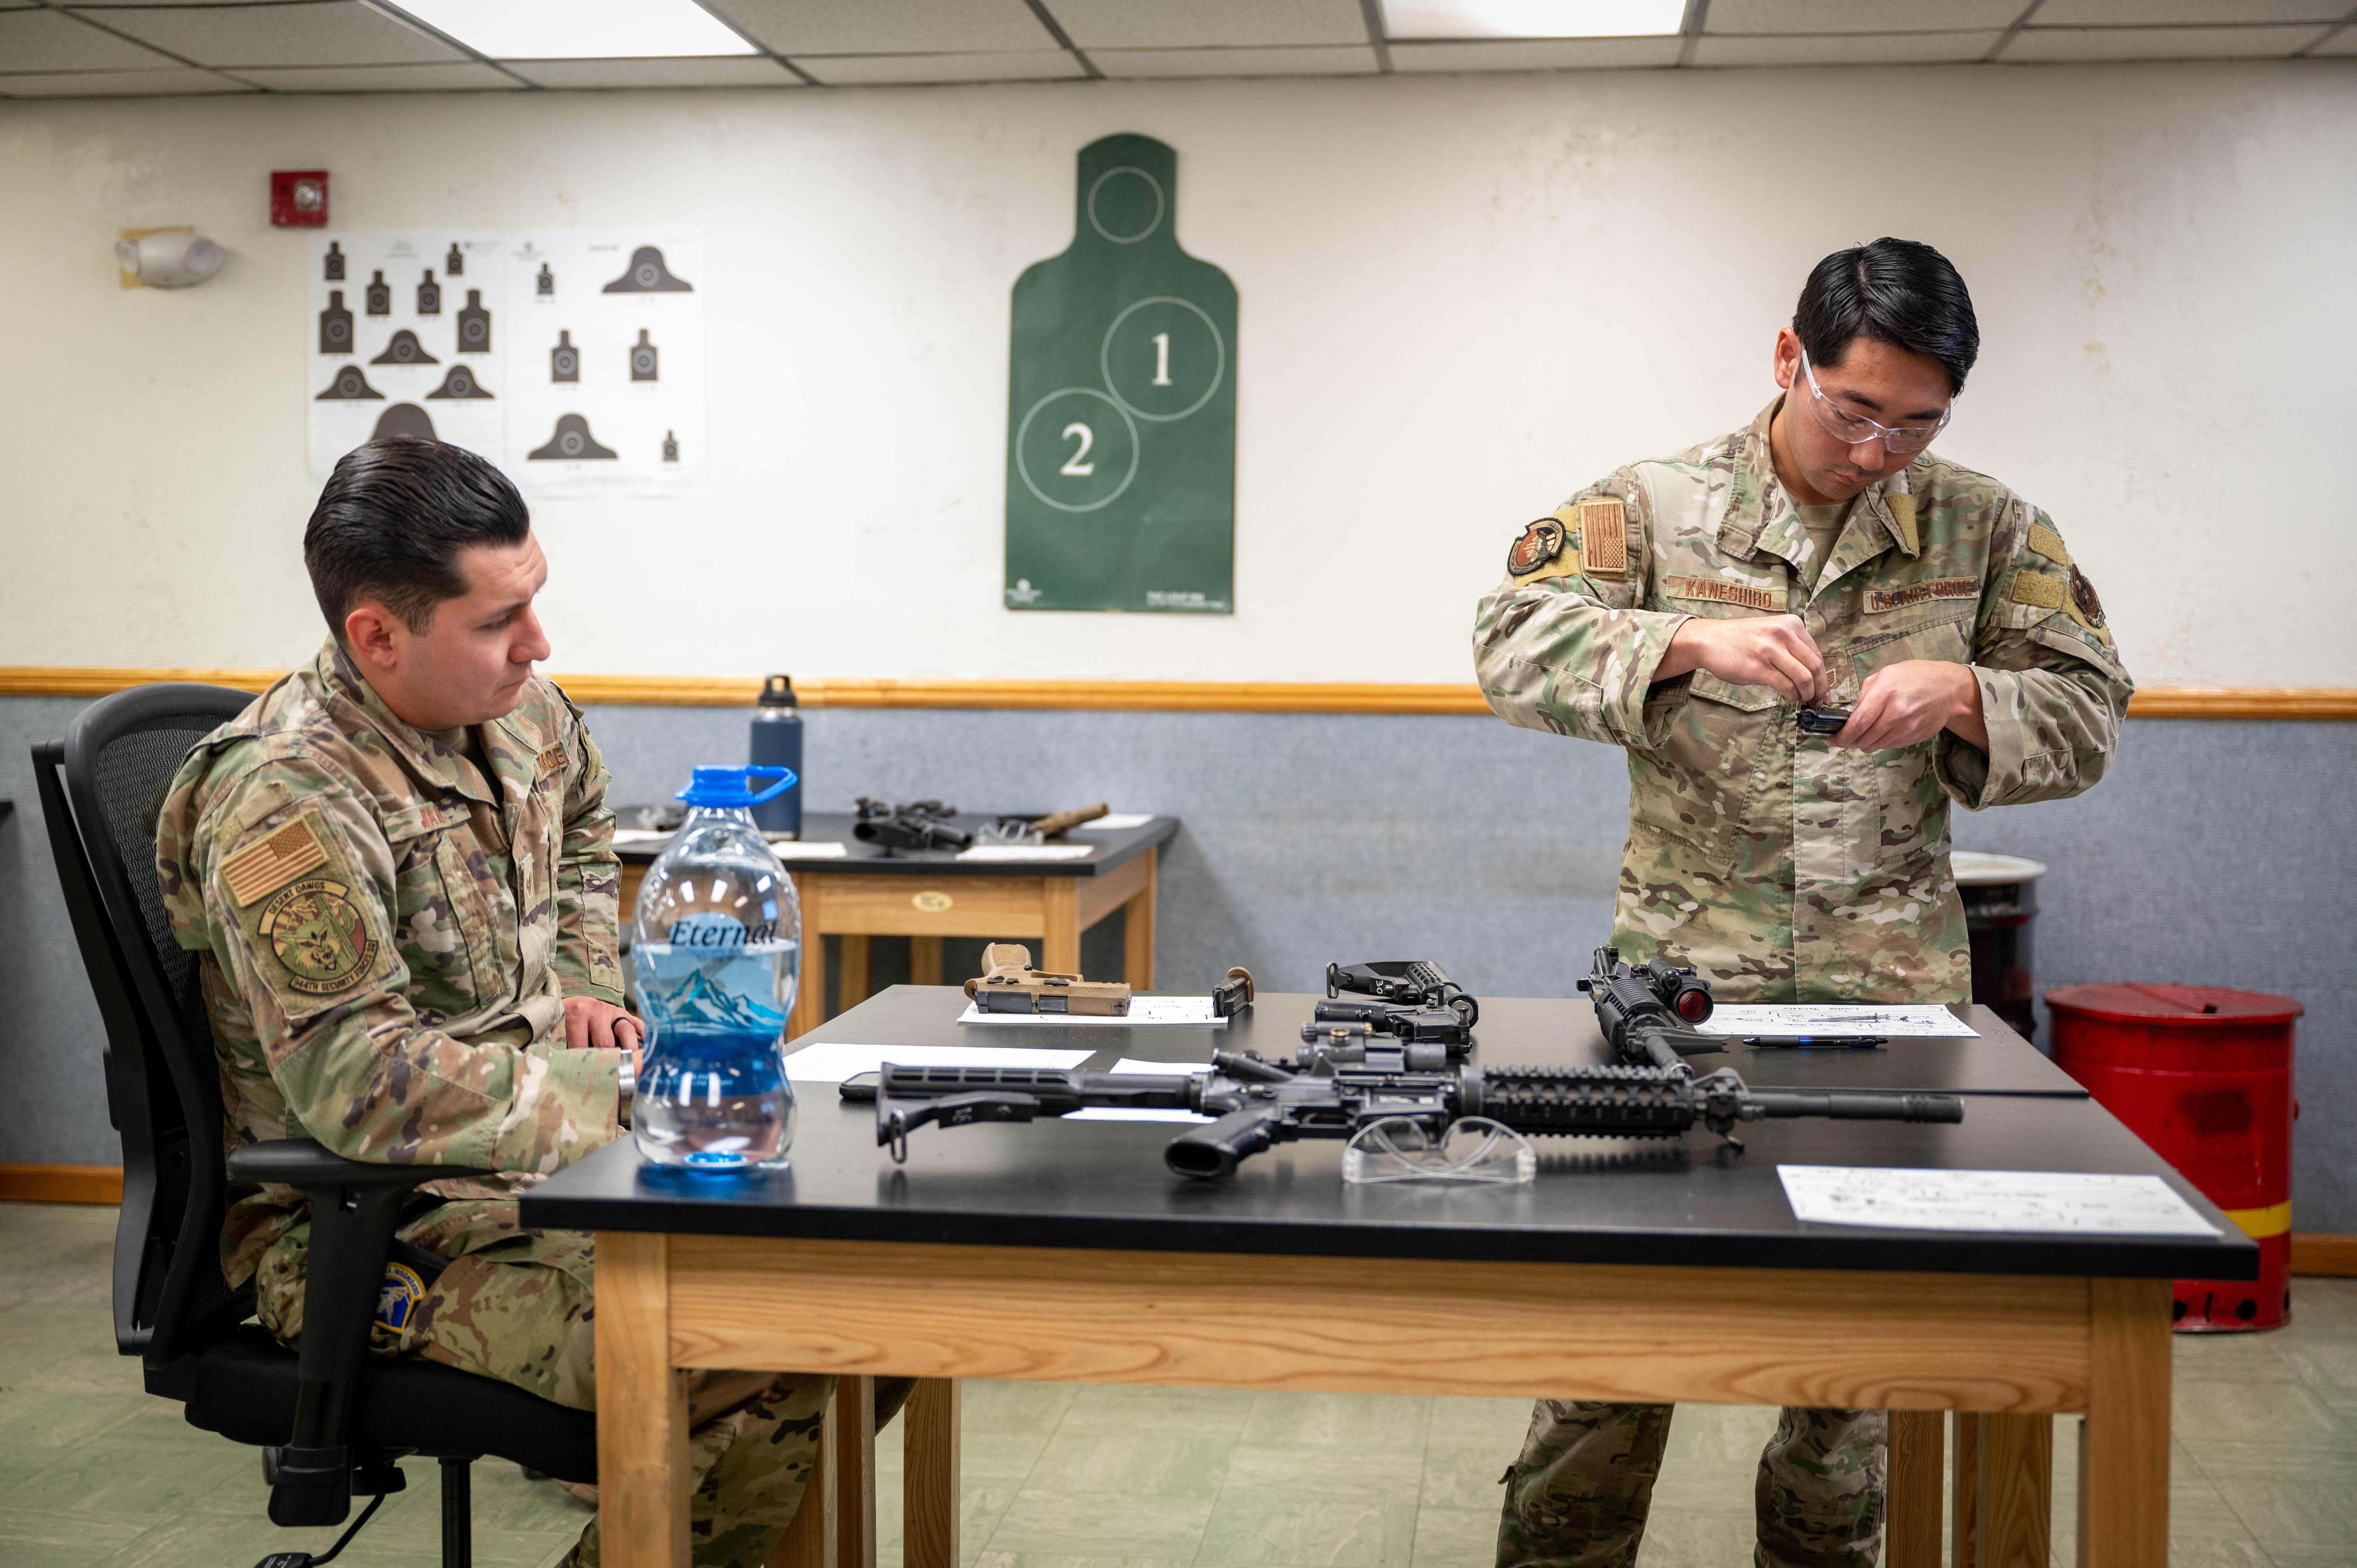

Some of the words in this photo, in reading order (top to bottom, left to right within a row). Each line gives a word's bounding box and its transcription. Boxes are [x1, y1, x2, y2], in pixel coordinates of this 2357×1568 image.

[1152, 332, 1172, 385] 1
[1060, 422, 1094, 476] 2
[1686, 579, 1771, 607] KANESHIRO
[1871, 593, 1897, 611] U.S.
[1901, 586, 1924, 606] AIR
[1926, 580, 1972, 599] FORCE
[268, 890, 293, 914] DESERT
[295, 881, 325, 893] DAWGS
[670, 920, 779, 946] Eternal
